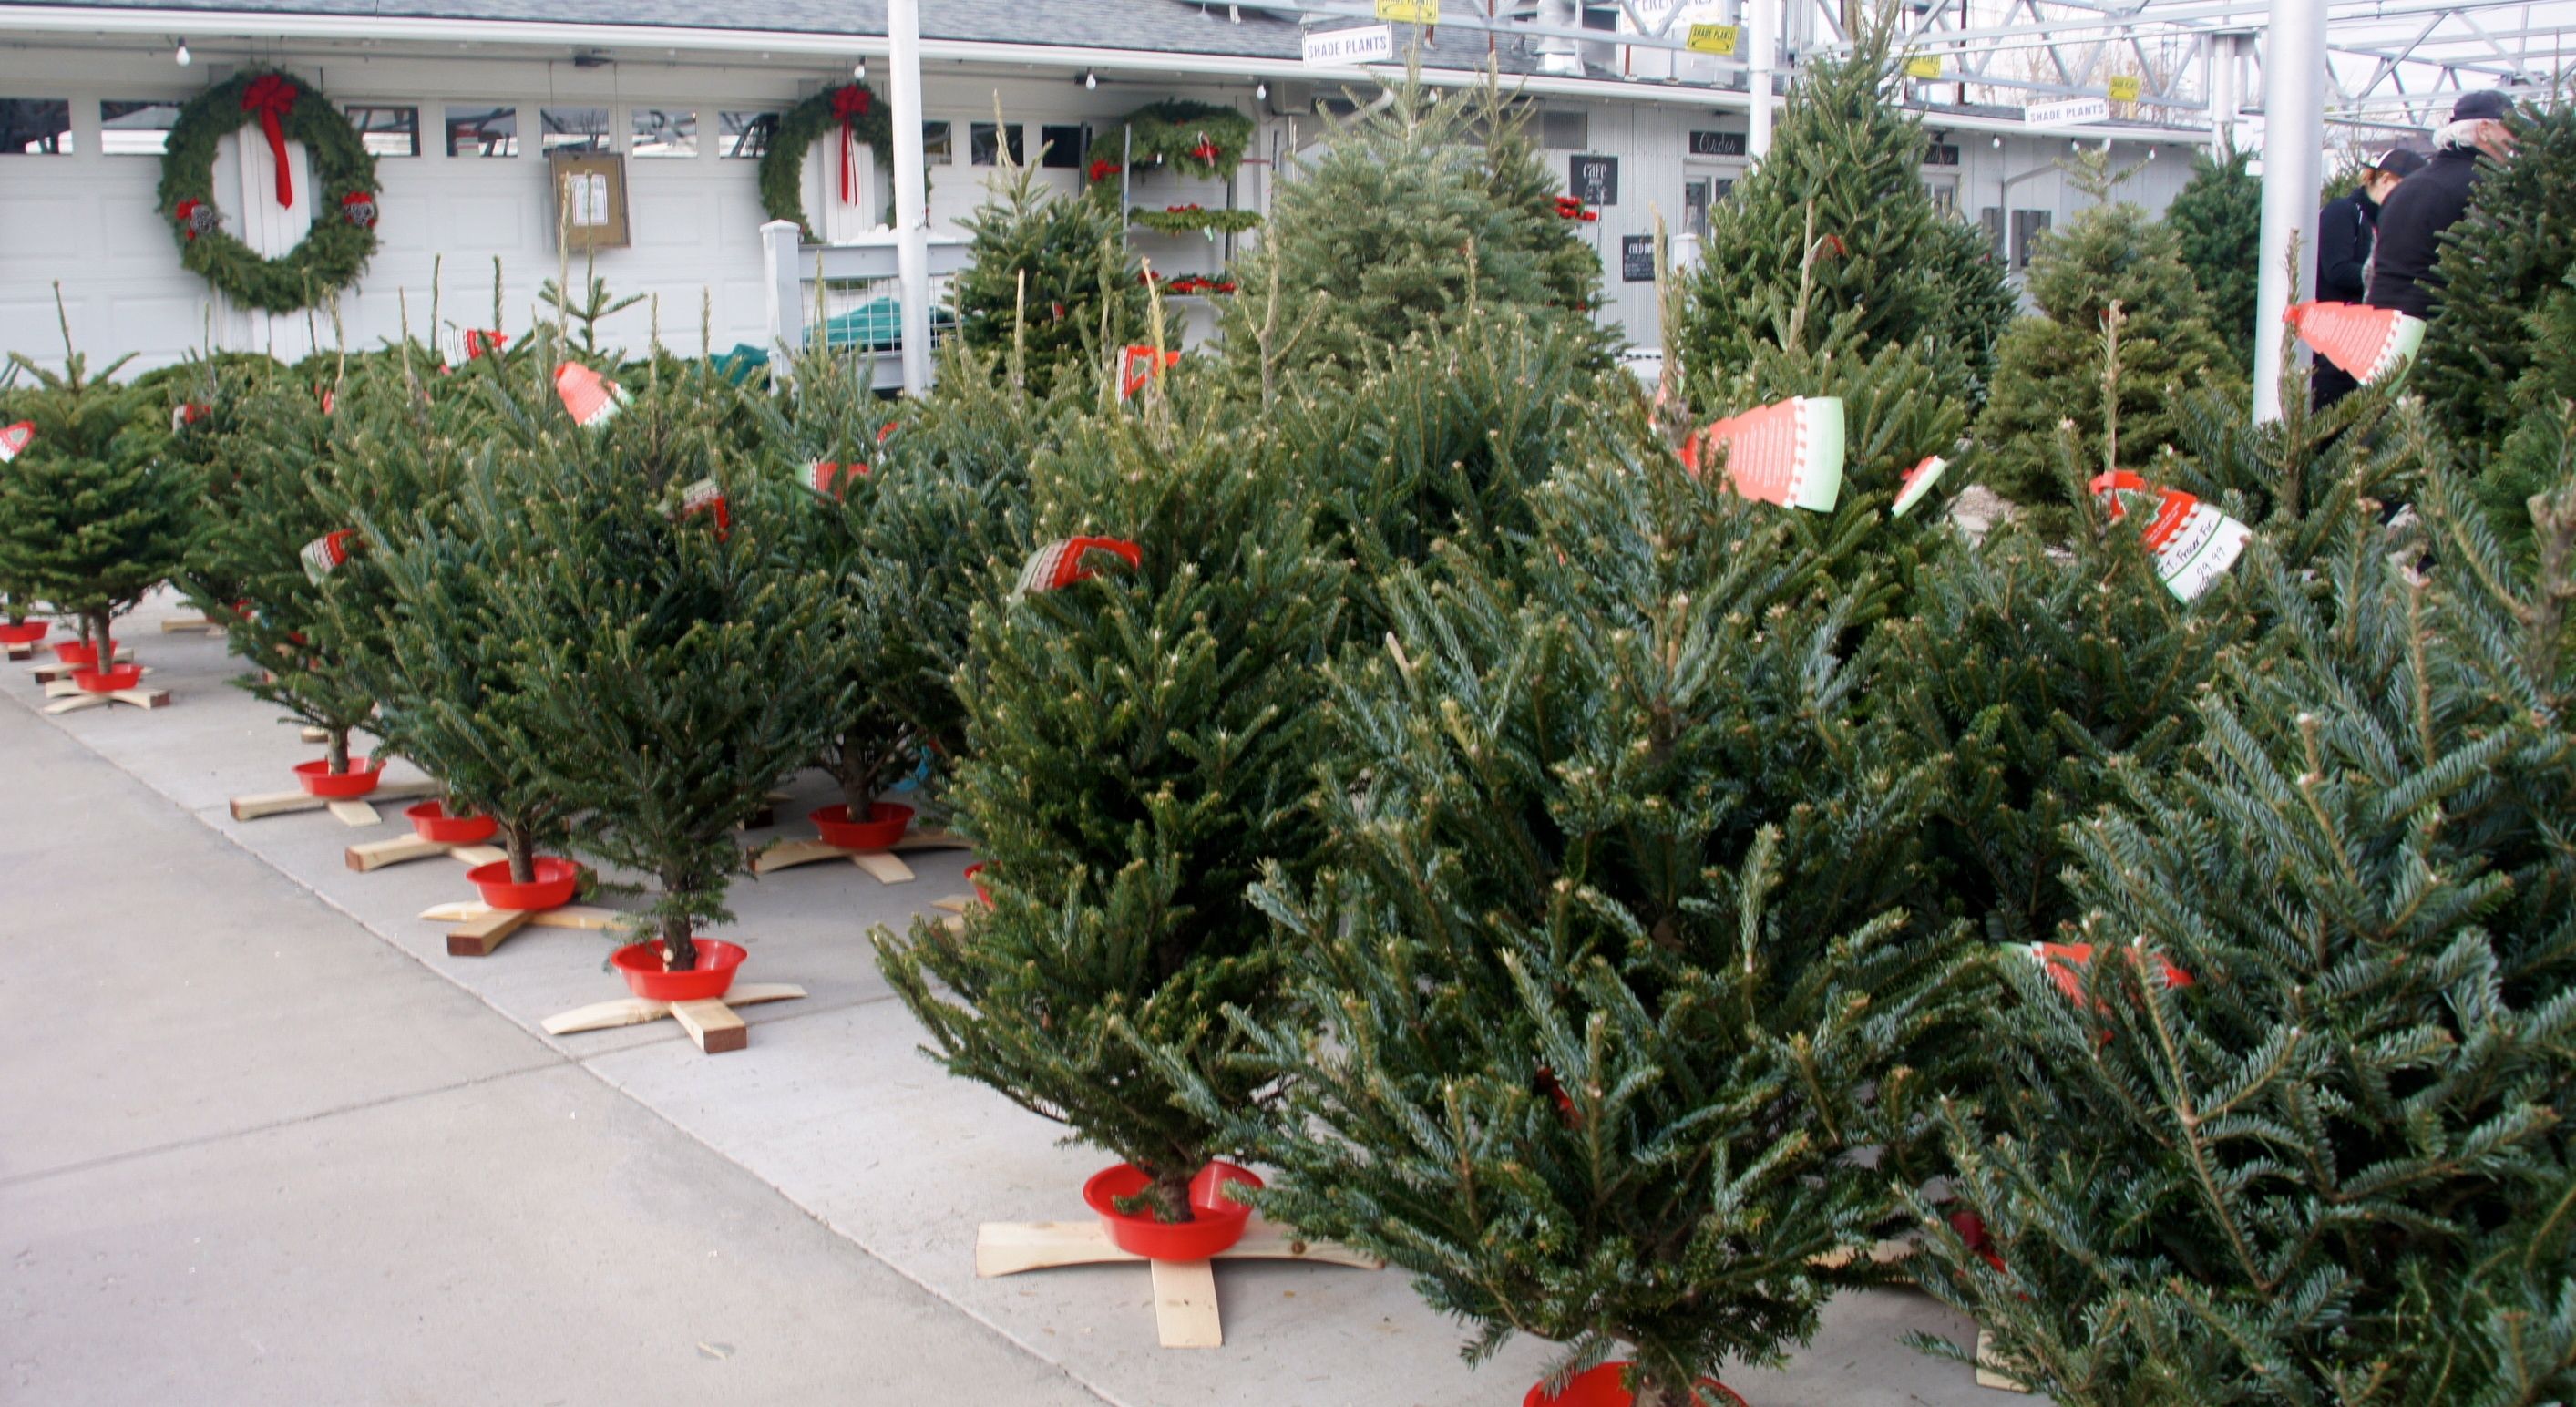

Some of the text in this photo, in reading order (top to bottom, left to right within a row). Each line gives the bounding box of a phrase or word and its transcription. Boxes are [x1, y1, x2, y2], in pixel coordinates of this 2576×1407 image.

[1694, 27, 1735, 40] SHADE PLANTS
[1308, 36, 1387, 58] SHADE PLANTS
[2030, 102, 2105, 123] SHADE PLANTS
[2200, 520, 2212, 537] Fir
